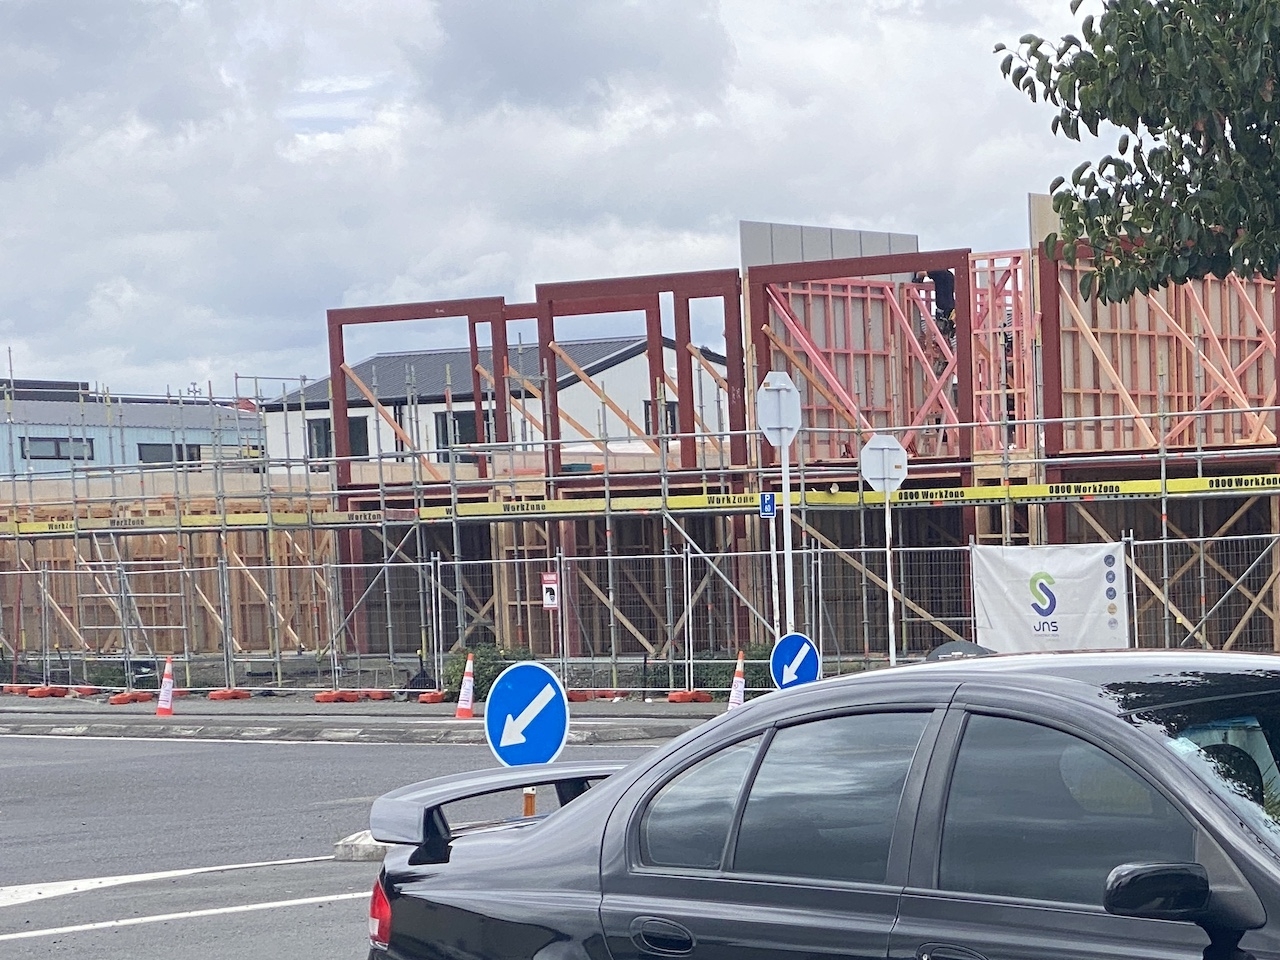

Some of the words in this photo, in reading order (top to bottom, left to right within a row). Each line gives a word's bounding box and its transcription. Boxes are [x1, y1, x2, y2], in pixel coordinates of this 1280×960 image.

[1208, 478, 1233, 488] 0800
[1048, 485, 1072, 494] 0800
[1074, 484, 1120, 494] WorkZone
[707, 494, 755, 504] WorkZone
[764, 494, 771, 503] P
[898, 491, 920, 500] 0800
[921, 490, 965, 499] WorkZone
[503, 502, 546, 512] WorkZone
[347, 512, 382, 521] WorkZon
[109, 518, 145, 527] WorkZone
